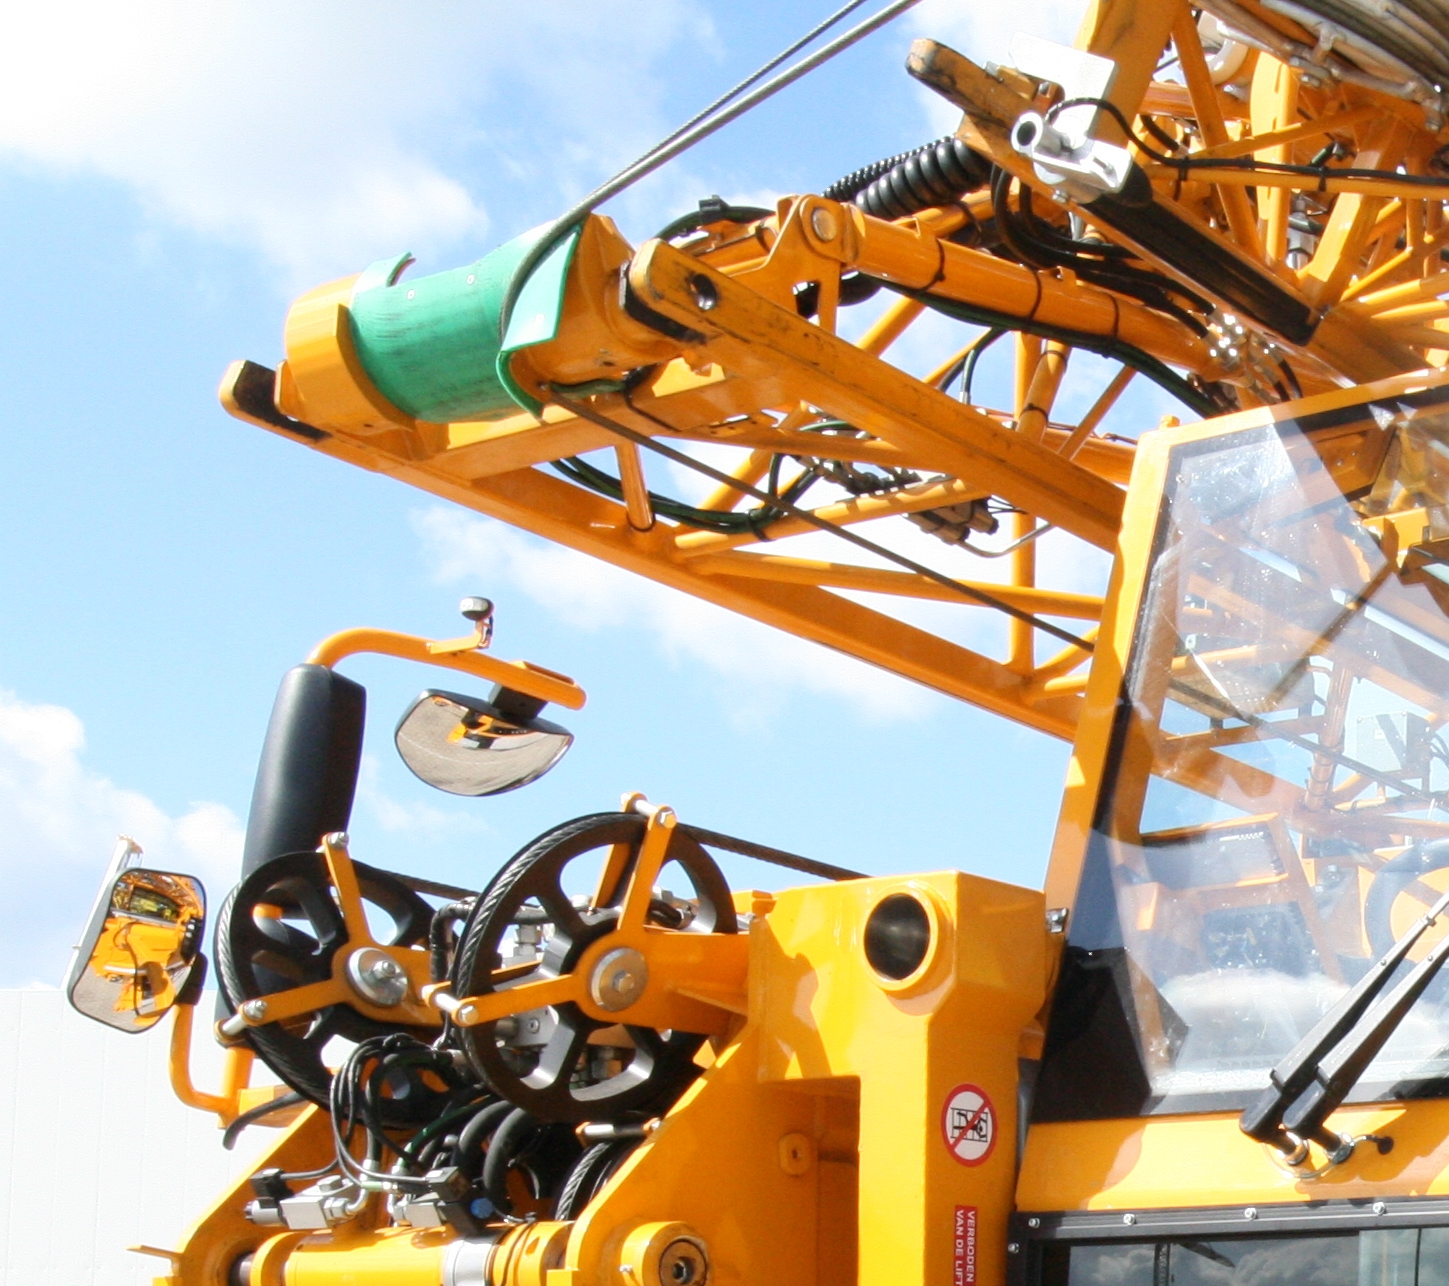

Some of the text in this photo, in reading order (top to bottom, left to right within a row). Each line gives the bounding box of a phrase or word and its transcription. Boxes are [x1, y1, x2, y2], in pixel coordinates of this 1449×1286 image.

[955, 1210, 964, 1236] VAN
[955, 1239, 964, 1256] DE
[966, 1210, 976, 1282] VERBODEN
